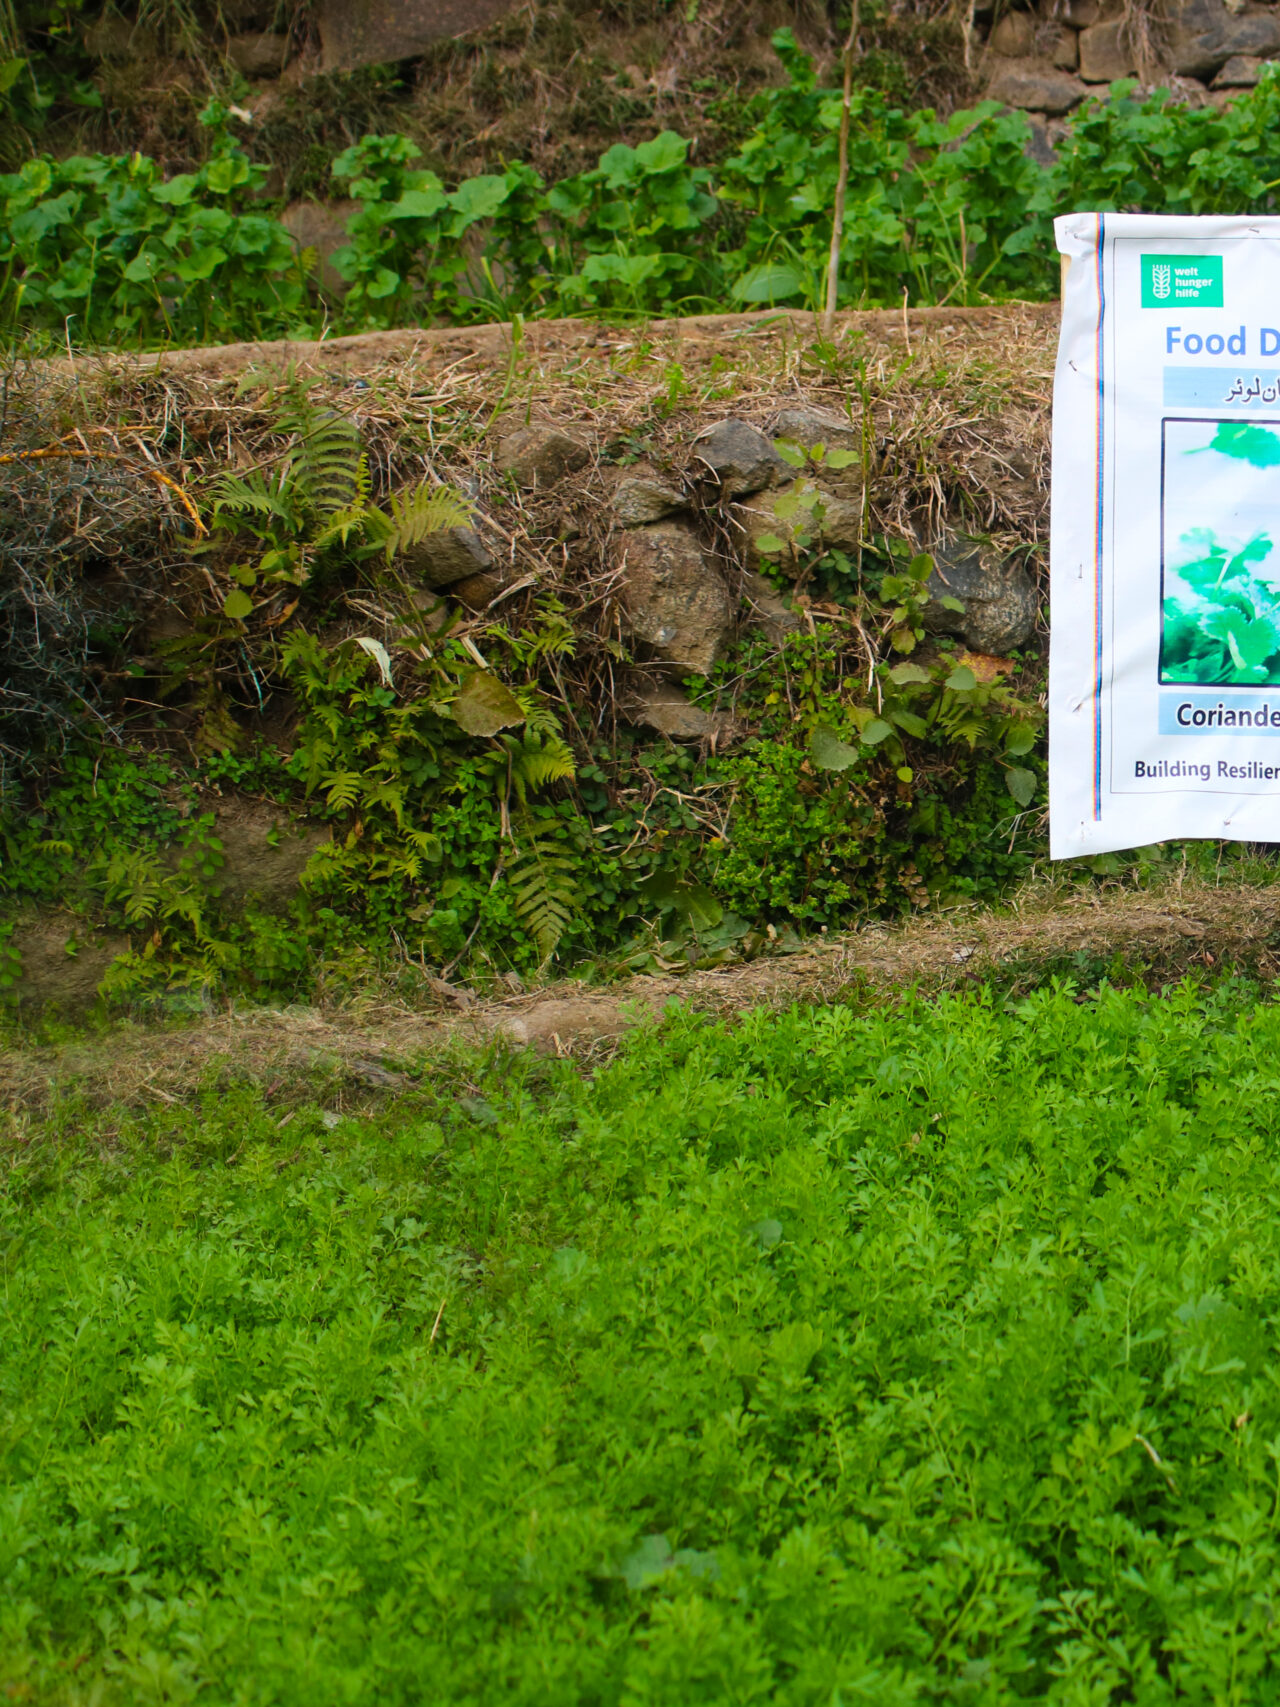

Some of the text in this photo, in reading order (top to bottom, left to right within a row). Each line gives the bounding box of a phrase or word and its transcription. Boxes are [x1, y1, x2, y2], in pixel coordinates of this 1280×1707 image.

[1174, 267, 1199, 276] welt
[1175, 278, 1213, 289] hunger
[1175, 289, 1200, 298] hilfe
[1166, 325, 1246, 355] Food
[1135, 761, 1210, 781] Building
